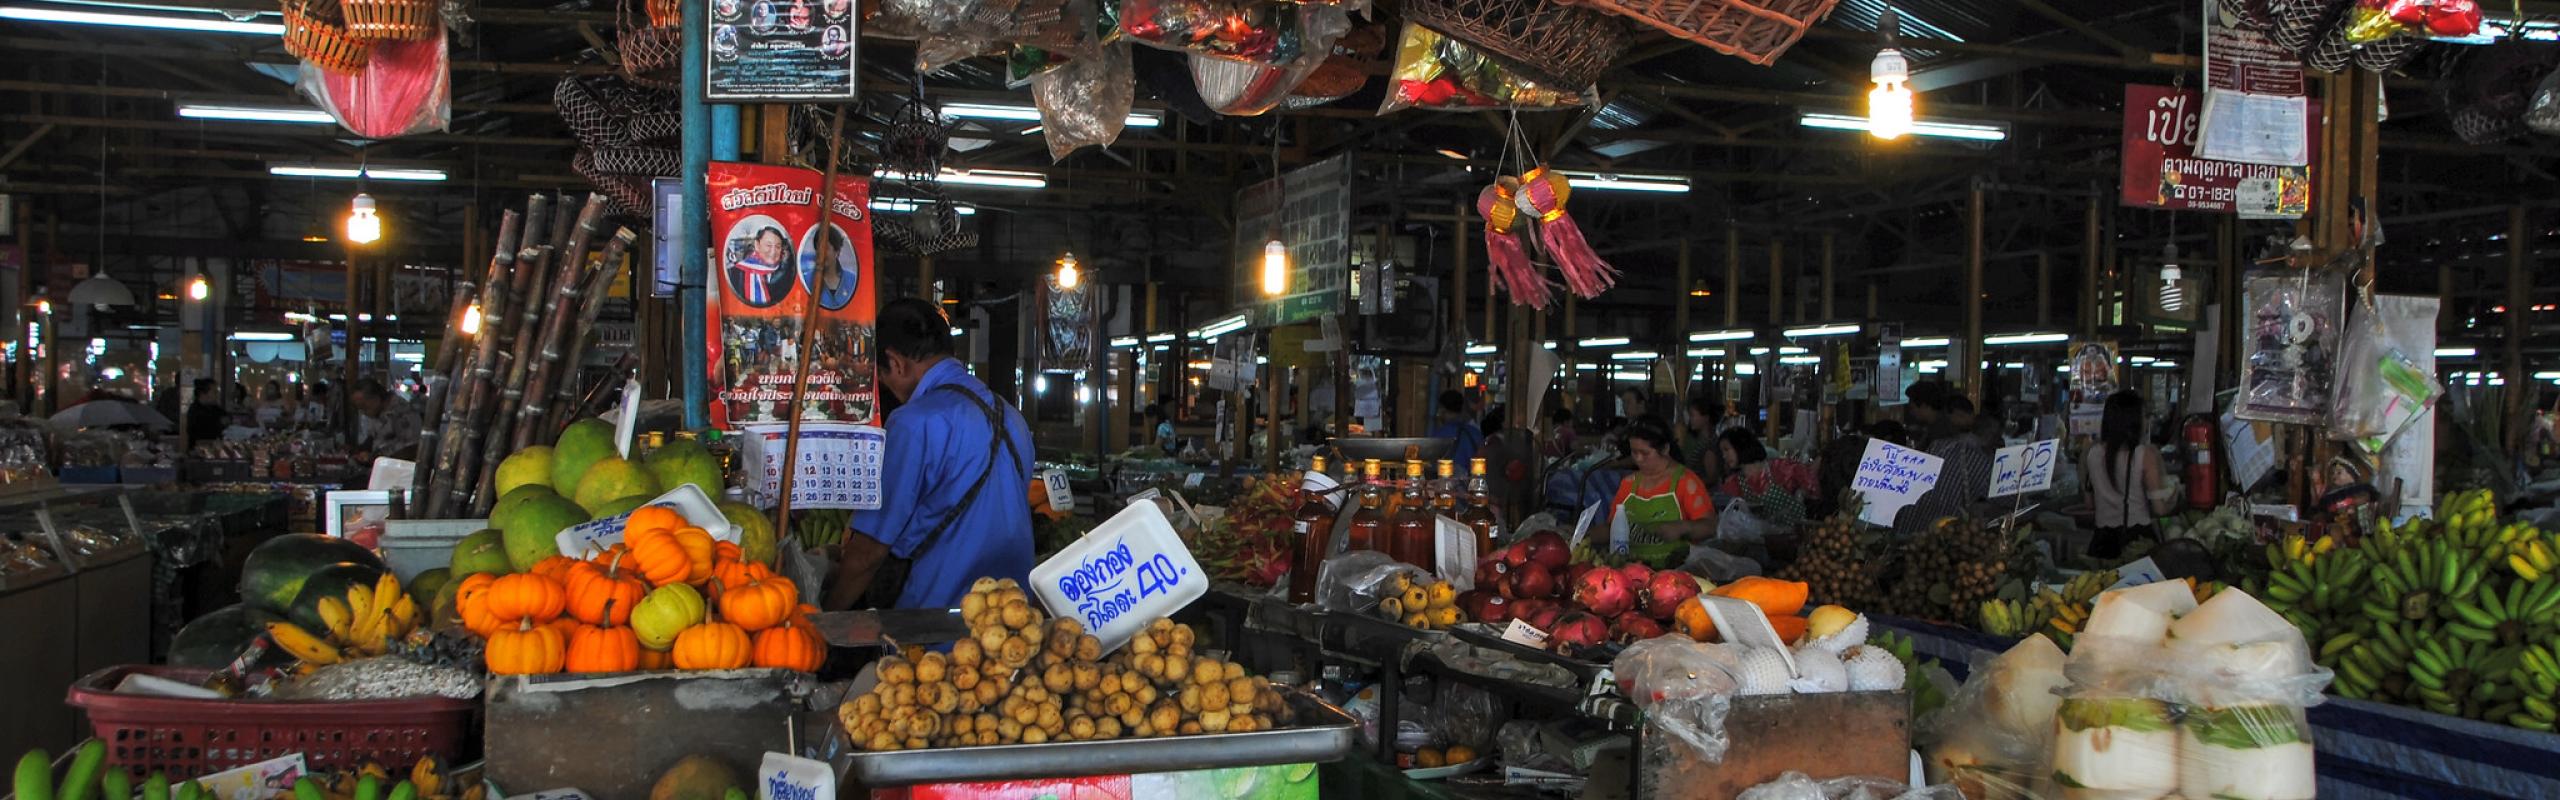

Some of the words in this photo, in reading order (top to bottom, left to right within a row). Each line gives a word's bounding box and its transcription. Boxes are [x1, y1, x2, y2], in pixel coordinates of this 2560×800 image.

[2161, 158, 2243, 182] ตามฤดูกาล
[722, 184, 812, 210] สวัสดีปีใหม่
[2188, 186, 2236, 202] 07-1821
[759, 371, 842, 385] นายกใดวงใจ
[719, 387, 873, 404] ขวัญใจประชนตลอดกาล
[2021, 441, 2052, 475] 25
[766, 468, 777, 477] 10
[804, 466, 817, 475] 12
[822, 467, 831, 475] 13
[836, 467, 846, 475] 14
[852, 468, 862, 476] 15
[867, 468, 877, 476] 16
[768, 482, 777, 490] 17
[805, 480, 817, 488] 19
[822, 480, 832, 489] 20
[837, 481, 846, 489] 21
[852, 481, 862, 490] 22
[866, 482, 877, 490] 23
[1050, 474, 1066, 490] 20
[805, 493, 817, 501] 26
[822, 493, 832, 501] 27
[837, 494, 847, 502] 28
[852, 494, 862, 502] 29
[866, 494, 877, 503] 30
[1059, 535, 1133, 602] ลองกอง
[1137, 553, 1187, 599] 40.
